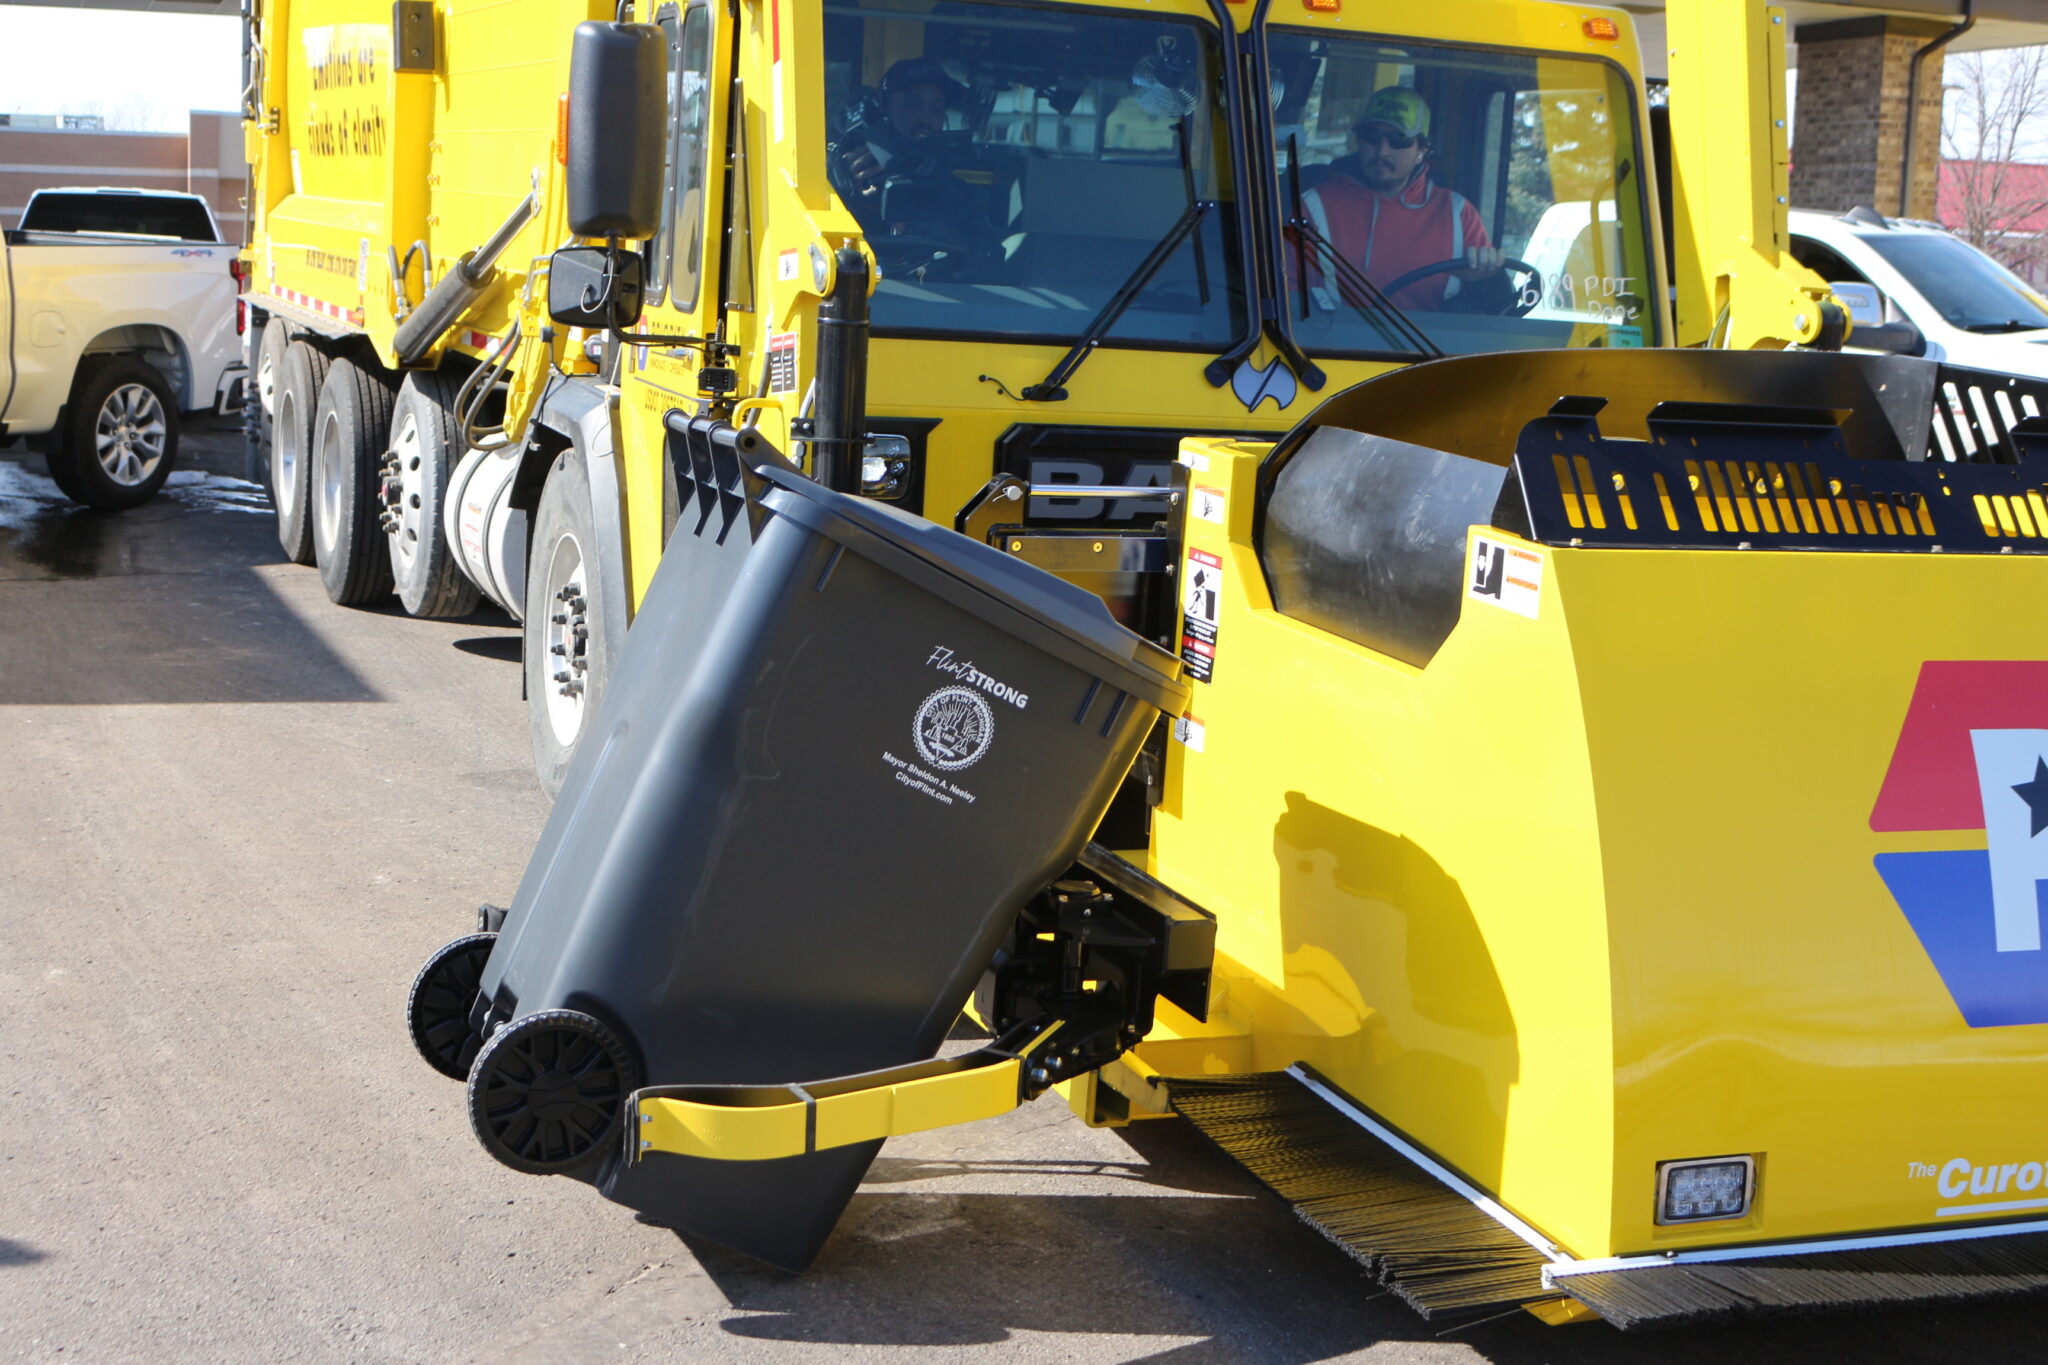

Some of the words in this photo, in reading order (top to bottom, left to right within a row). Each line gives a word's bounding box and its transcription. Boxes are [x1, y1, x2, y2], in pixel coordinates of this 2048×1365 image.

[358, 46, 375, 86] are
[338, 107, 348, 156] of
[353, 103, 386, 157] clarity
[1521, 271, 1577, 312] 6189
[1584, 275, 1638, 297] PDI
[940, 697, 950, 705] OF
[973, 704, 985, 744] MICHIGAN
[882, 751, 908, 769] Mayor
[908, 763, 940, 784] Sheldon
[940, 779, 948, 789] A.
[949, 784, 976, 803] Neeley
[895, 771, 953, 805] CityofFlint.com
[1908, 1162, 1938, 1178] The
